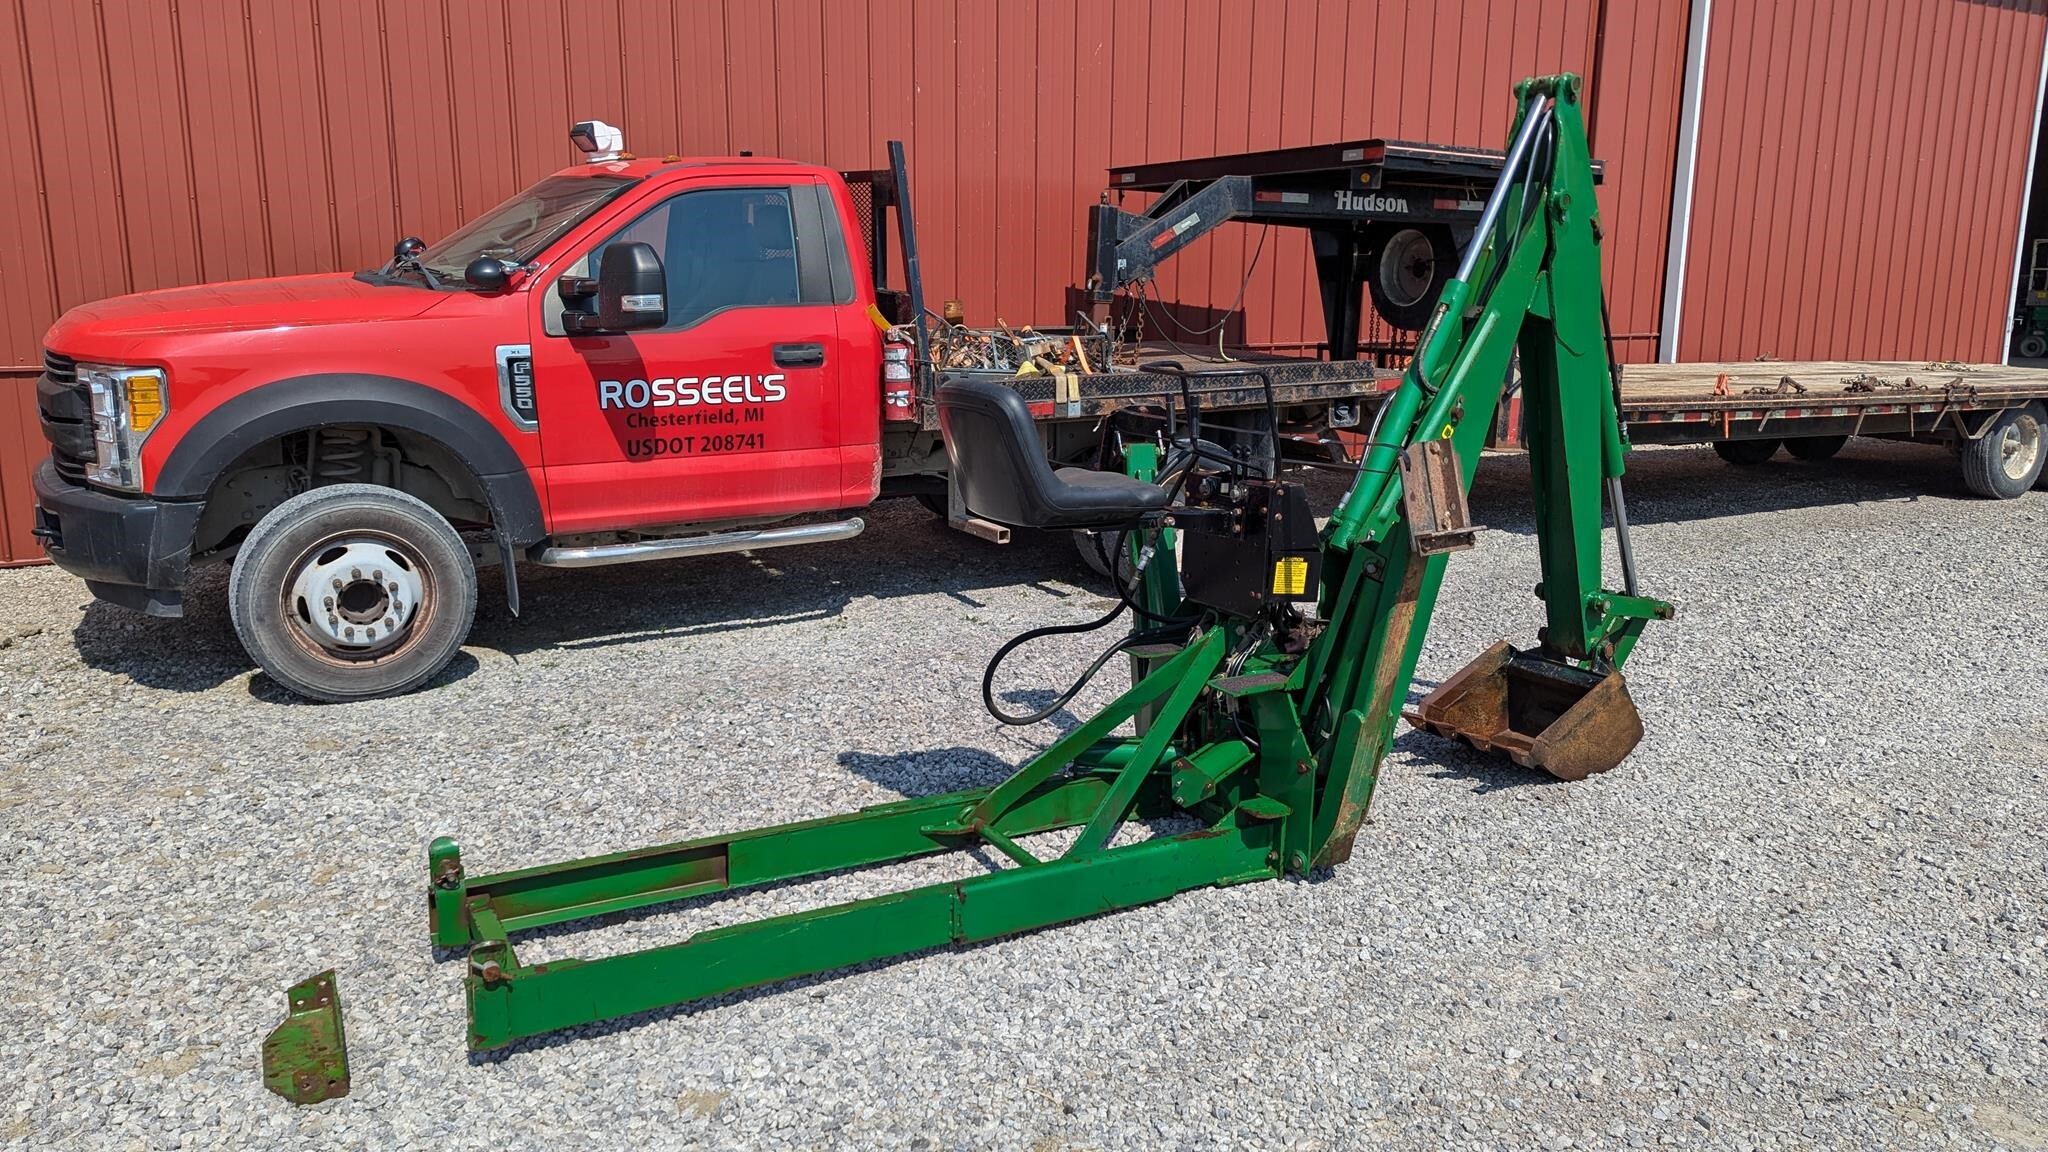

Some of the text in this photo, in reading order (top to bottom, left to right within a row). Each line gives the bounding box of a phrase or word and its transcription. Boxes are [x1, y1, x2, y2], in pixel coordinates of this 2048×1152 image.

[1334, 190, 1409, 213] Hudson
[513, 361, 533, 409] F550
[599, 374, 787, 410] ROSSEEL'S
[626, 408, 764, 429] Chesterfield, MI
[627, 433, 765, 457] USDOT 208741
